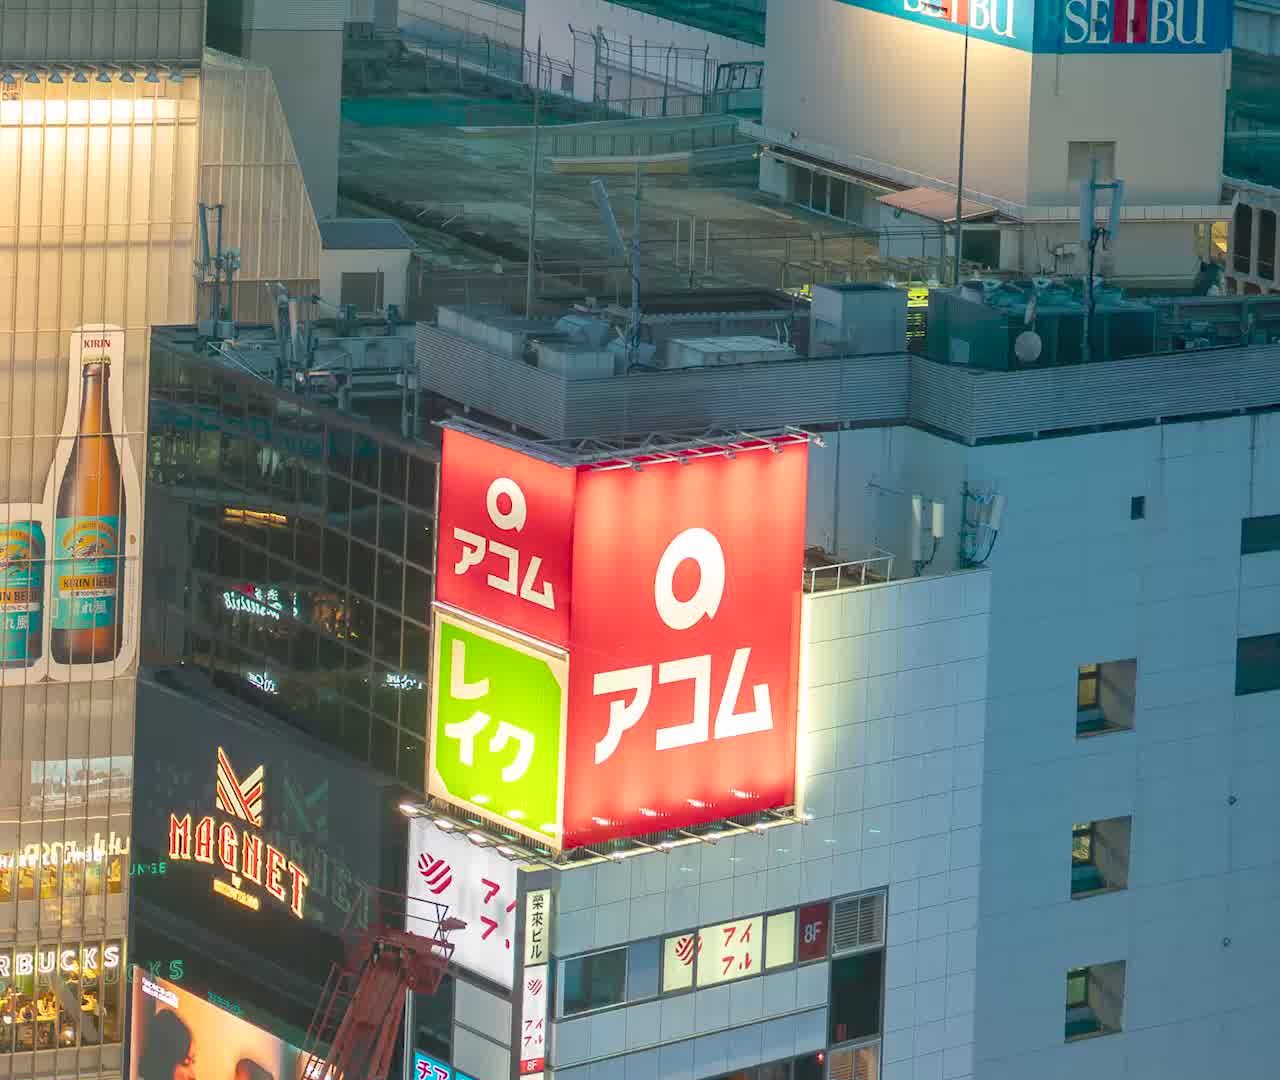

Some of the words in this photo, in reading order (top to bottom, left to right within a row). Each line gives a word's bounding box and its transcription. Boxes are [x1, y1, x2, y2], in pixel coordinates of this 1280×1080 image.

[84, 338, 112, 349] KIRIN
[453, 527, 556, 610] アコム
[592, 647, 774, 765] アコム
[168, 812, 310, 920] MAGNET
[804, 921, 822, 944] 8F
[527, 1061, 537, 1071] 8F
